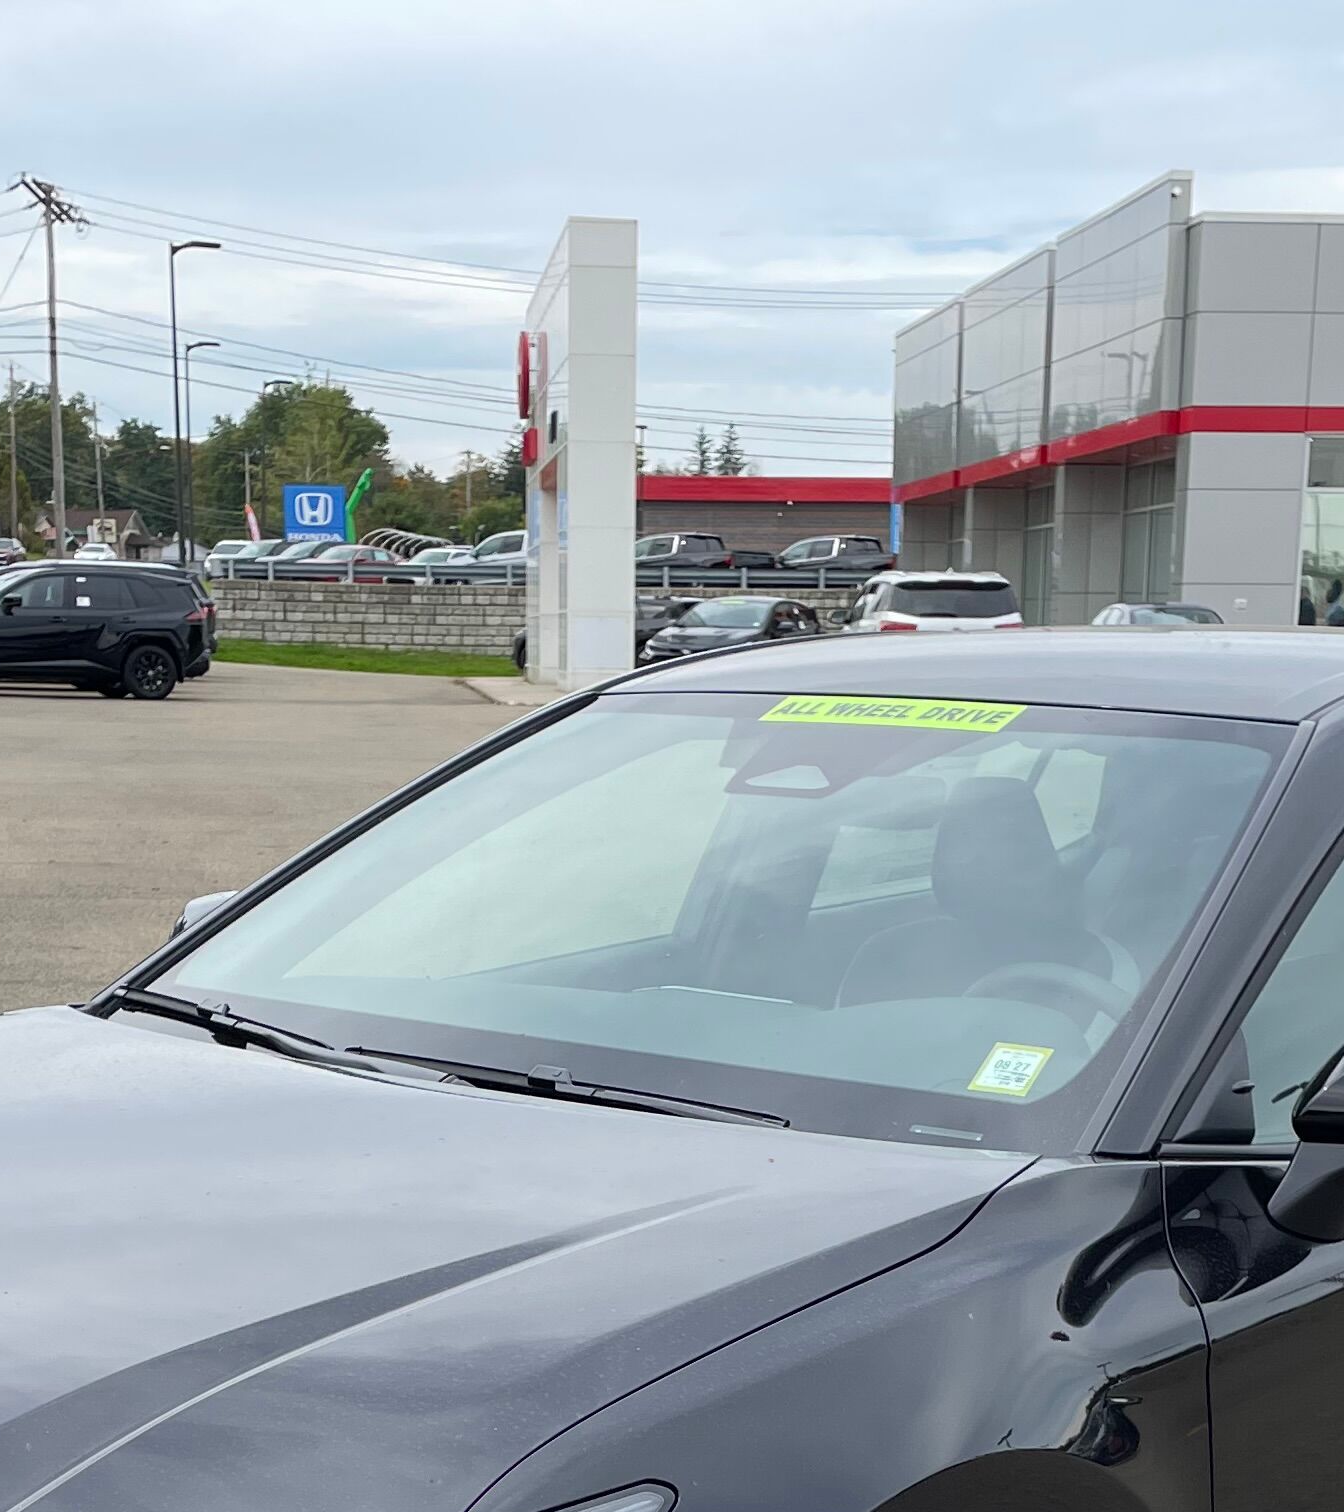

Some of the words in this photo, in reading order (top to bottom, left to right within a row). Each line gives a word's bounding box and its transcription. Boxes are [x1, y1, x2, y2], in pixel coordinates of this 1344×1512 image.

[770, 701, 824, 716] ALL
[824, 702, 916, 720] WHEEL
[916, 705, 1013, 725] DRIVE
[1013, 1061, 1031, 1072] 27
